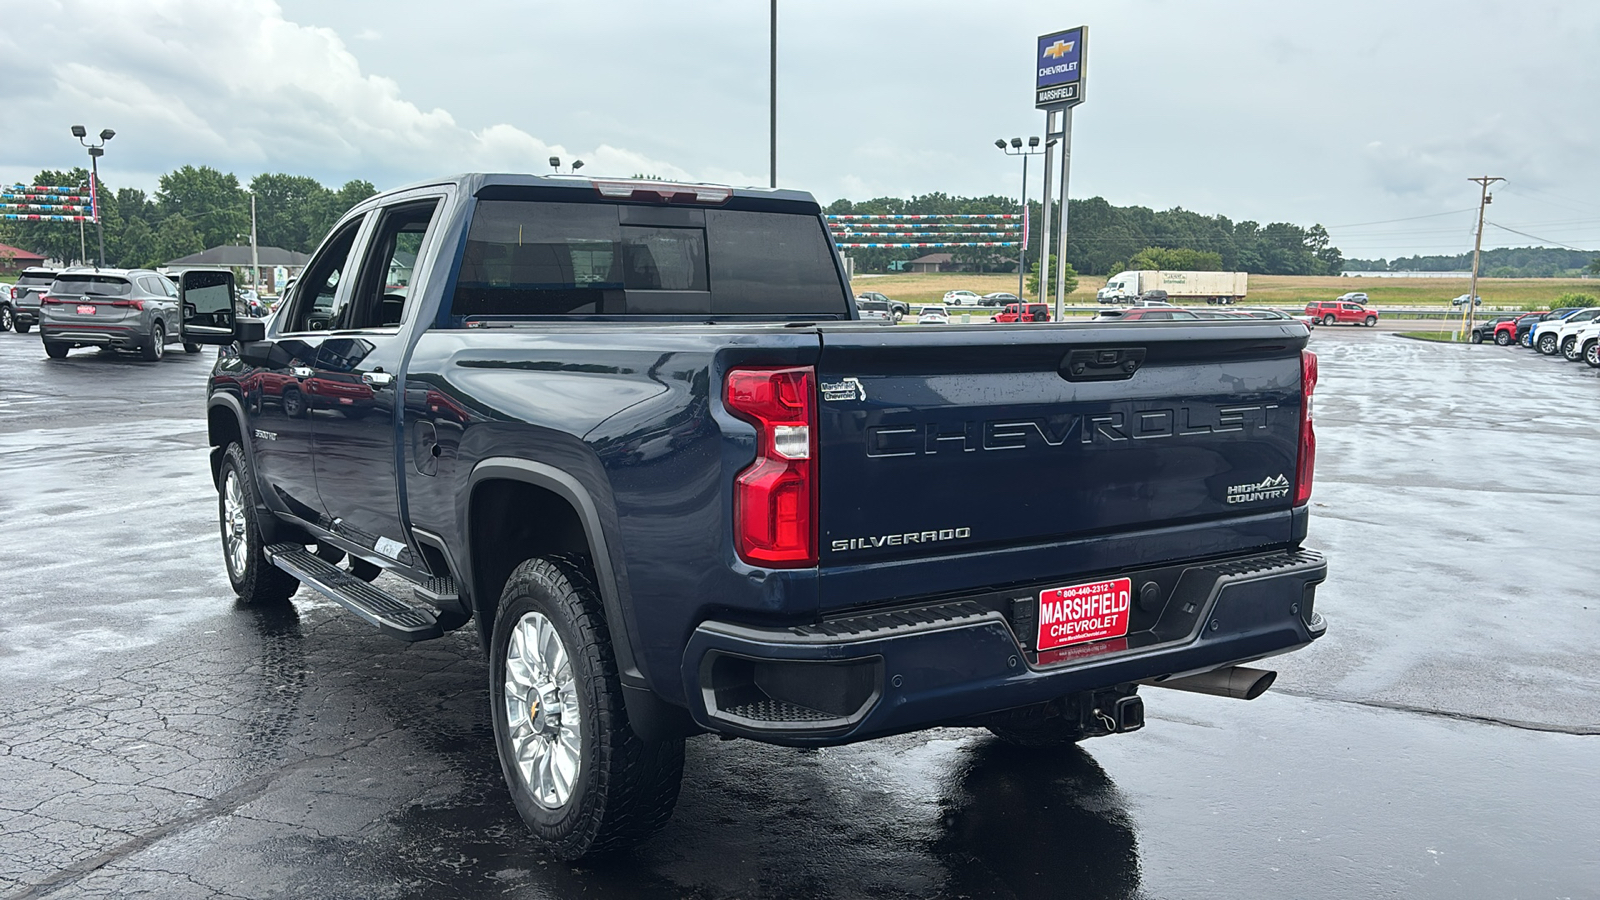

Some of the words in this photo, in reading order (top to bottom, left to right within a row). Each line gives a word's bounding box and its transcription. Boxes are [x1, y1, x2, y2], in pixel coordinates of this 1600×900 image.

[1039, 61, 1078, 77] CHEVROLET
[1039, 87, 1073, 101] MARSHFIELD
[821, 382, 855, 391] Marshfield
[825, 391, 855, 400] Chevrolet
[866, 404, 1278, 458] CHEVROLET
[1226, 489, 1290, 504] COUNTRY
[1227, 483, 1261, 495] HIGH
[831, 526, 971, 552] SILVERADO
[1063, 584, 1108, 598] 800-440-2312
[1041, 591, 1129, 625] MARSHFIELD
[1050, 614, 1119, 637] CHEVROLET
